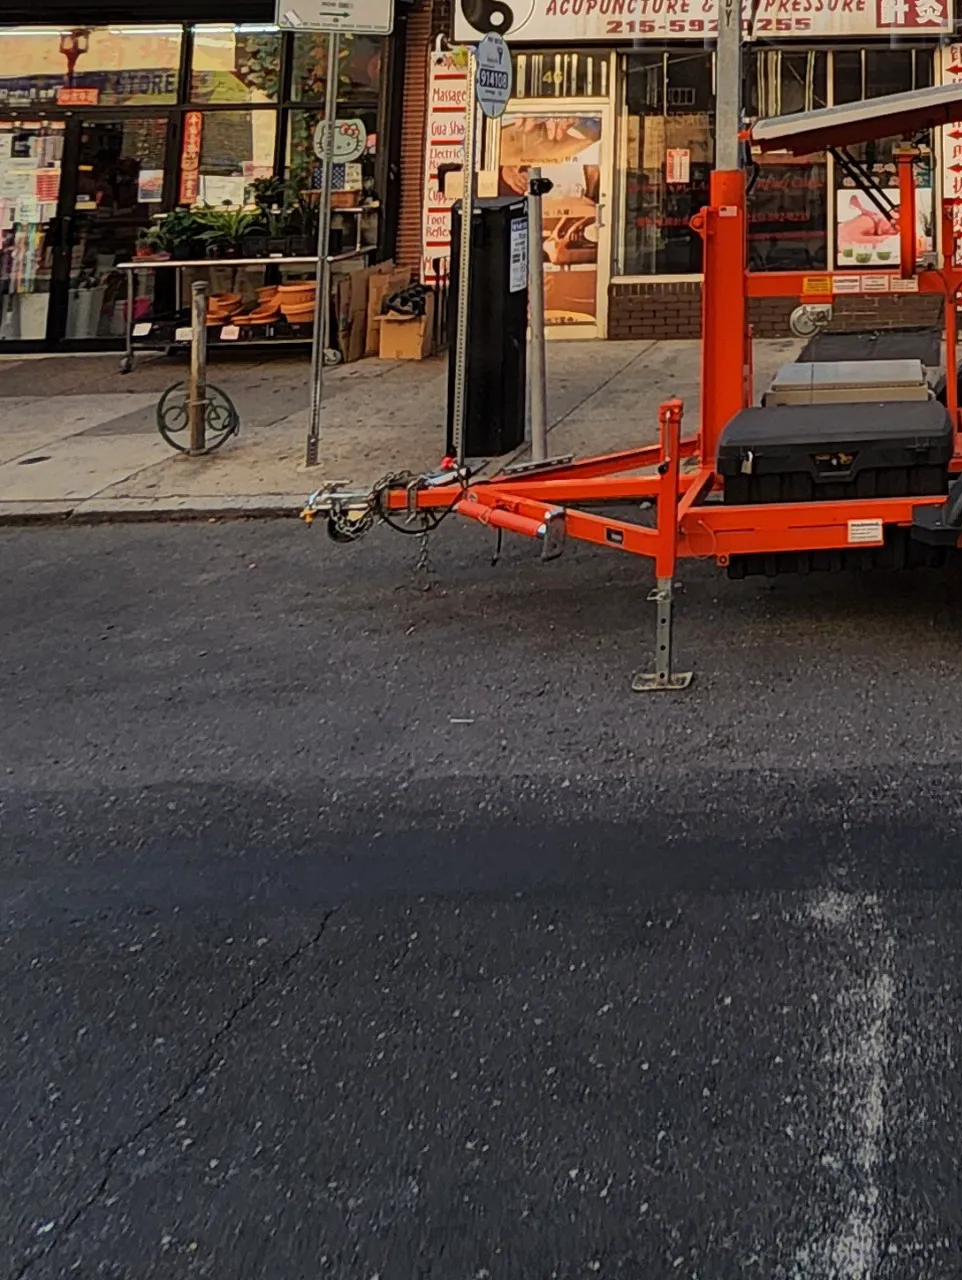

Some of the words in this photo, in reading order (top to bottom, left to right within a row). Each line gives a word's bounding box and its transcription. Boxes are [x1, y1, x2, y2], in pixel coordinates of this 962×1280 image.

[480, 70, 508, 89] 914108
[542, 70, 563, 84] 46
[432, 87, 467, 104] Massage
[431, 121, 447, 136] Gua
[450, 120, 466, 136] Sha
[427, 214, 446, 226] Foot
